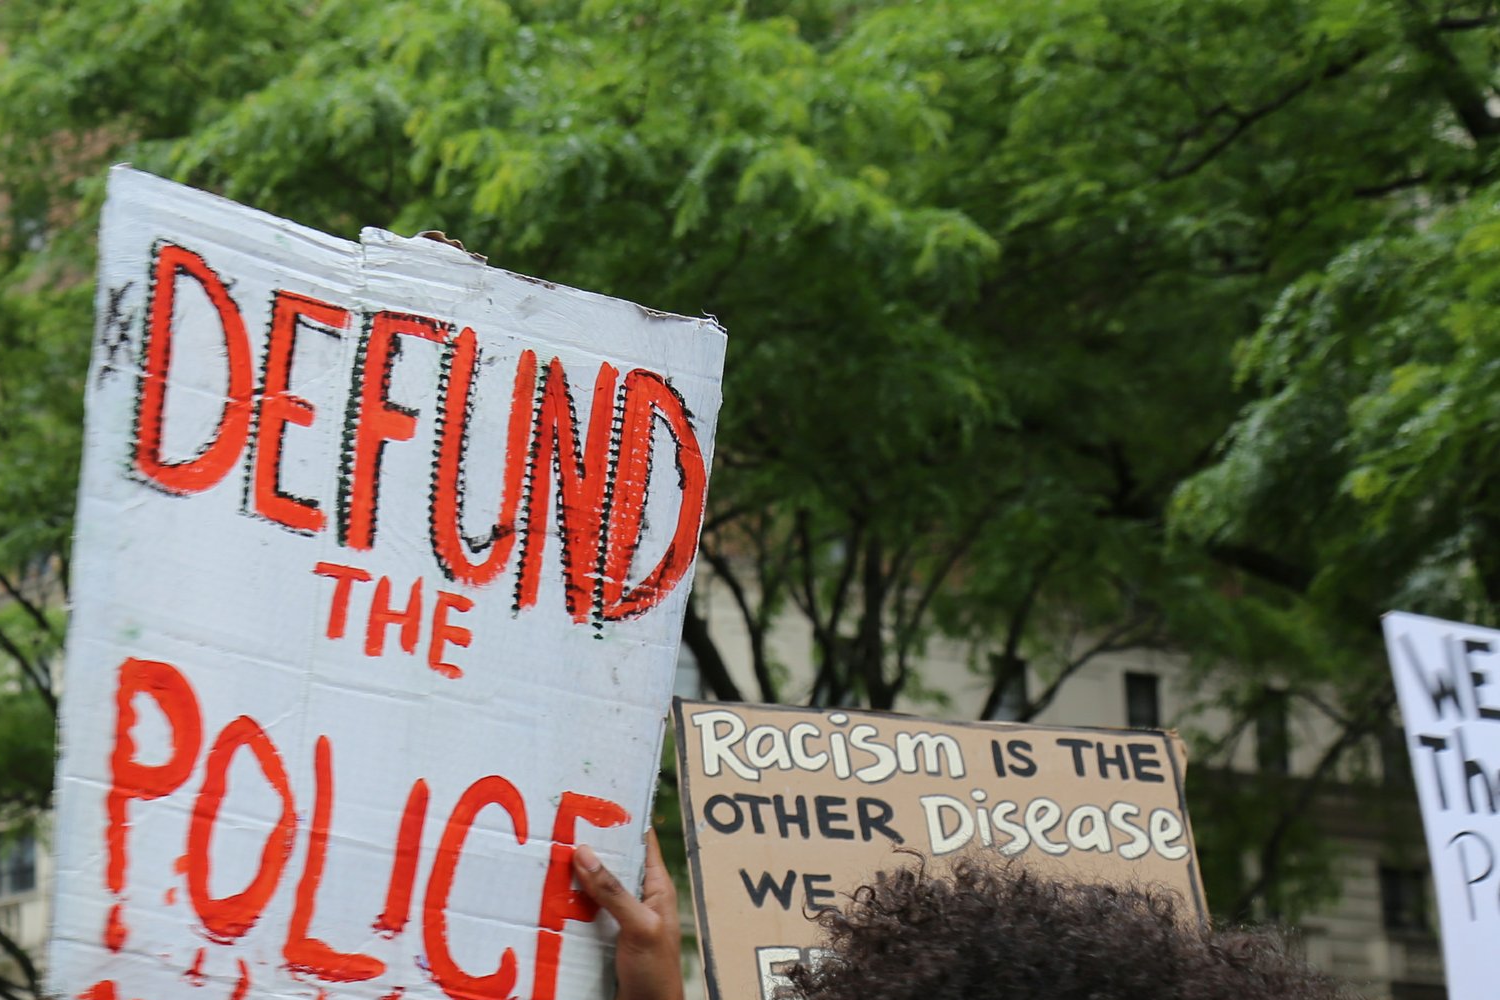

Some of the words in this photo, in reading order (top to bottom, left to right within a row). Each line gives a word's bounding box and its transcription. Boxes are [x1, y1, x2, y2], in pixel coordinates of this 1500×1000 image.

[129, 239, 707, 634] DEFUND
[313, 561, 477, 680] THE
[691, 710, 965, 783] Racism
[991, 739, 1038, 778] IS
[1056, 738, 1165, 782] THE
[1415, 725, 1500, 815] Th
[703, 793, 905, 844] OTHER
[919, 789, 1190, 861] Disease
[739, 868, 838, 912] WE
